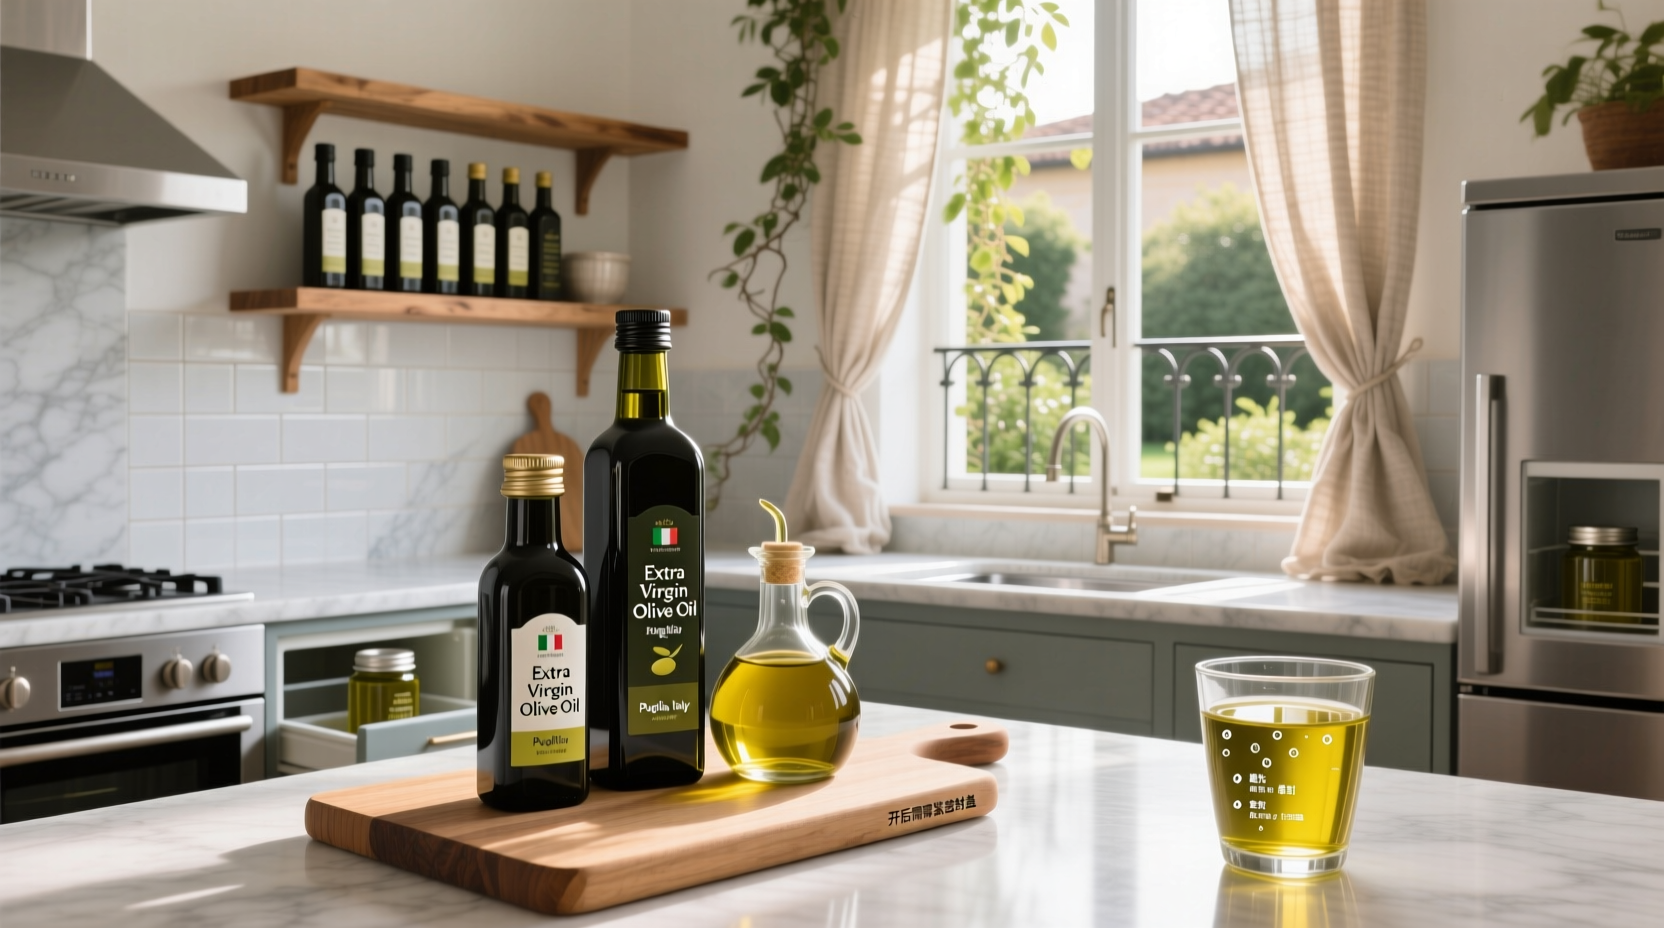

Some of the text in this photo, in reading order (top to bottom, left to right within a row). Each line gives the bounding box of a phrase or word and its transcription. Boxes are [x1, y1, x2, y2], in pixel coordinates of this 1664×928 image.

[645, 564, 685, 581] Extra
[639, 582, 688, 603] Virgin
[633, 600, 697, 619] Olive Oil
[532, 666, 570, 680] Extra
[527, 683, 573, 700] Virgin
[520, 698, 580, 716] Olive Oil
